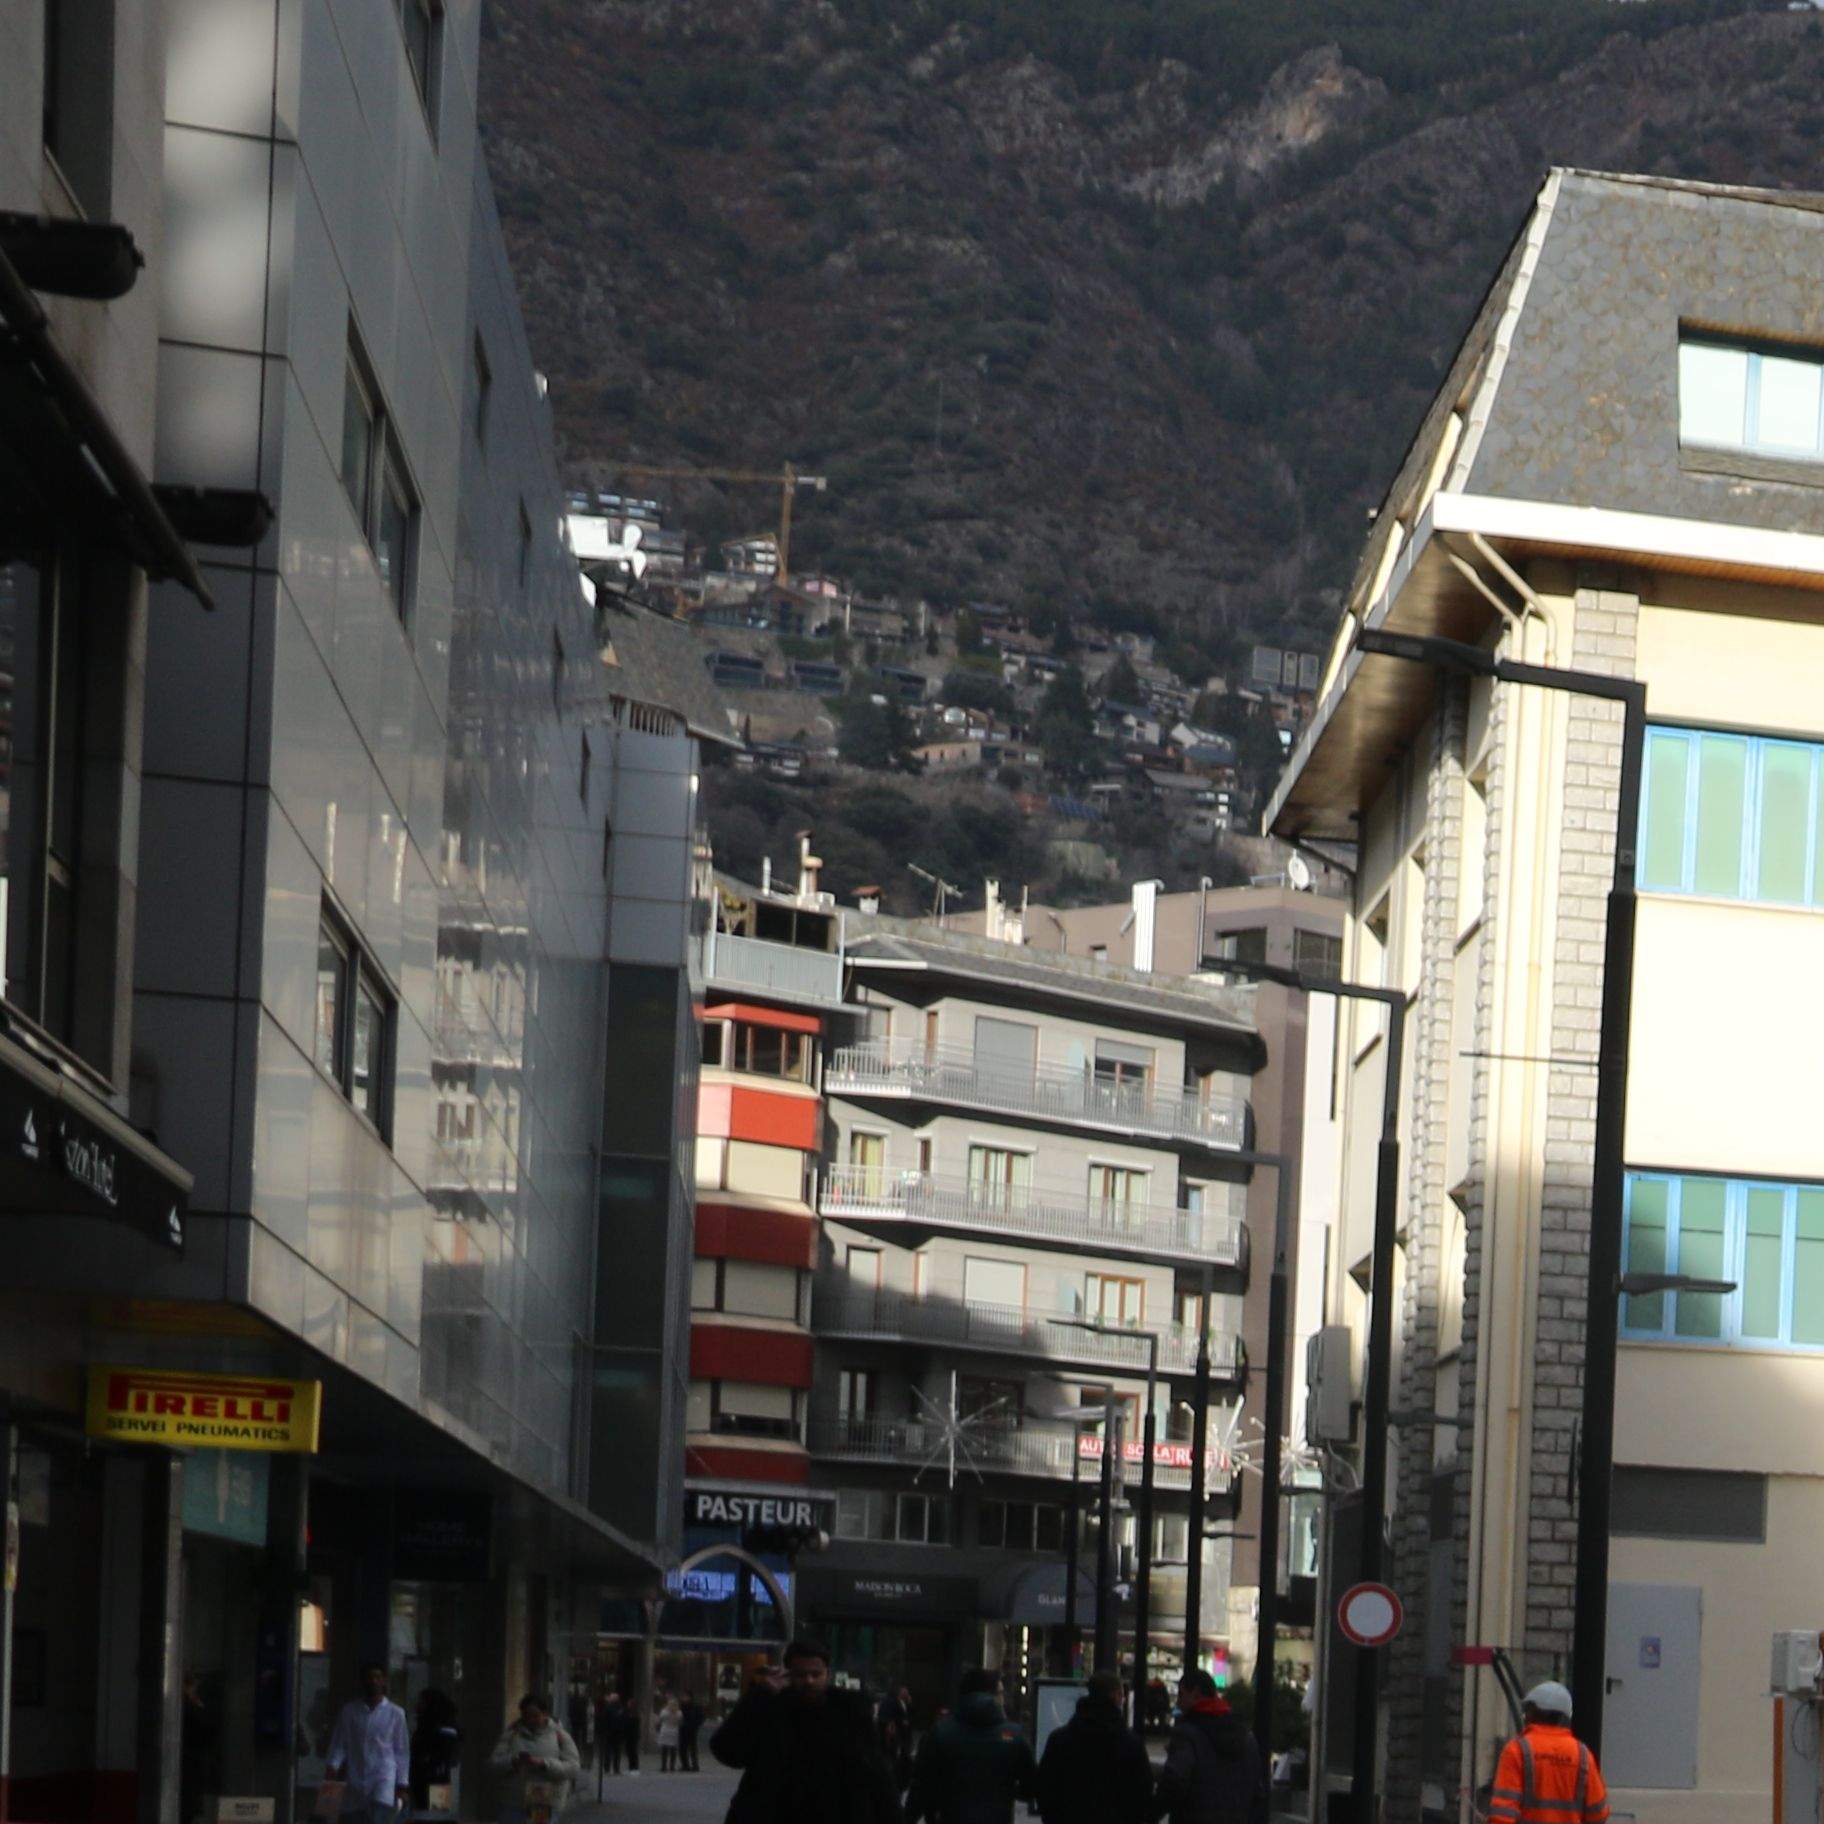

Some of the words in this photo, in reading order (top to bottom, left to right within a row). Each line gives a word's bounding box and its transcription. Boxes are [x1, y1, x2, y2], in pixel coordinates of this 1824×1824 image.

[107, 1372, 295, 1422] PIRELLI
[107, 1420, 167, 1434] SERVEI
[176, 1422, 290, 1441] PNEUMATICS
[695, 1494, 812, 1526] PASTEUR
